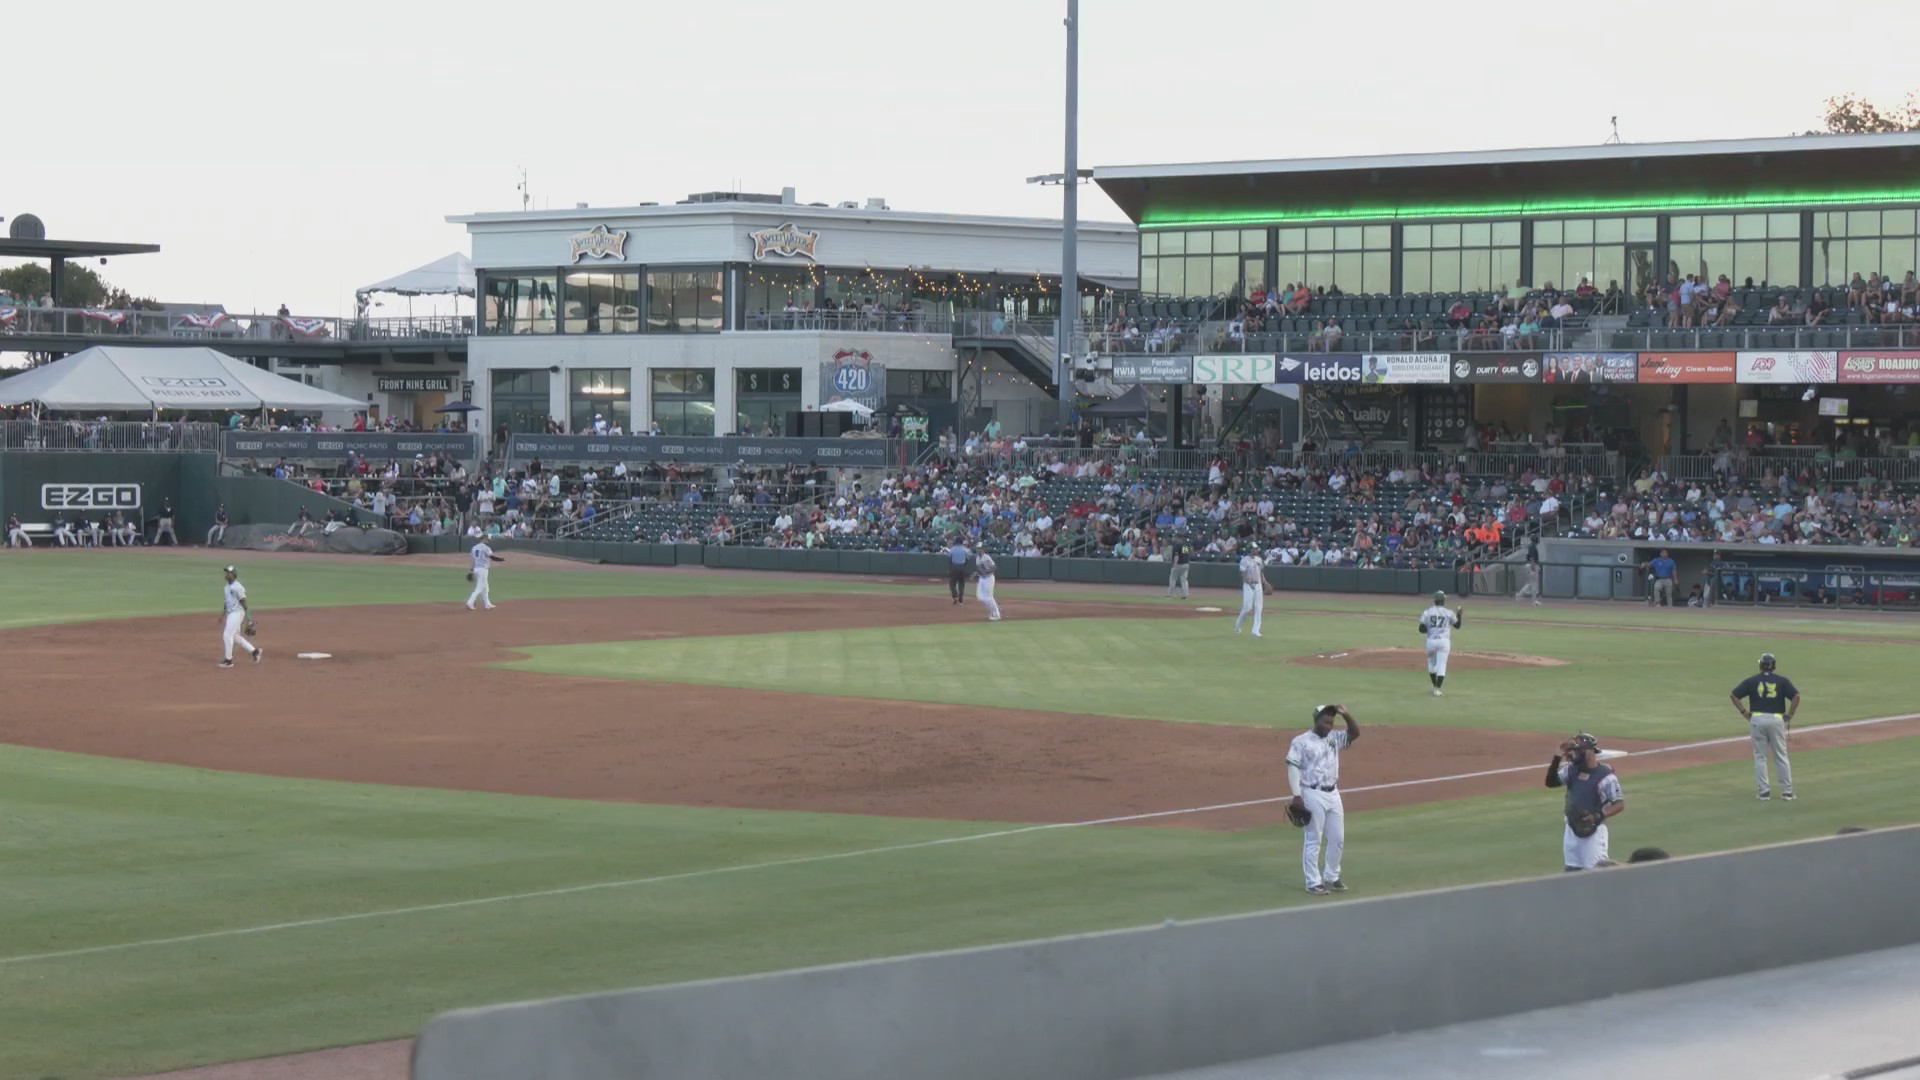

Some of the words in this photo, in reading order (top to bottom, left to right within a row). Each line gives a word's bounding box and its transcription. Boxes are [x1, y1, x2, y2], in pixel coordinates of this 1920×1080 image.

[1387, 356, 1413, 364] RONALD
[1751, 358, 1776, 371] ADP
[1879, 359, 1920, 370] ROADHO
[1114, 367, 1136, 376] NWIA
[1197, 357, 1273, 382] SRP
[1304, 362, 1361, 381] leidos
[380, 380, 404, 390] FRONT
[406, 380, 424, 390] NINE
[426, 380, 448, 390] GRILL
[838, 368, 866, 390] 420
[44, 486, 138, 507] EZGO
[1757, 681, 1777, 698] 13
